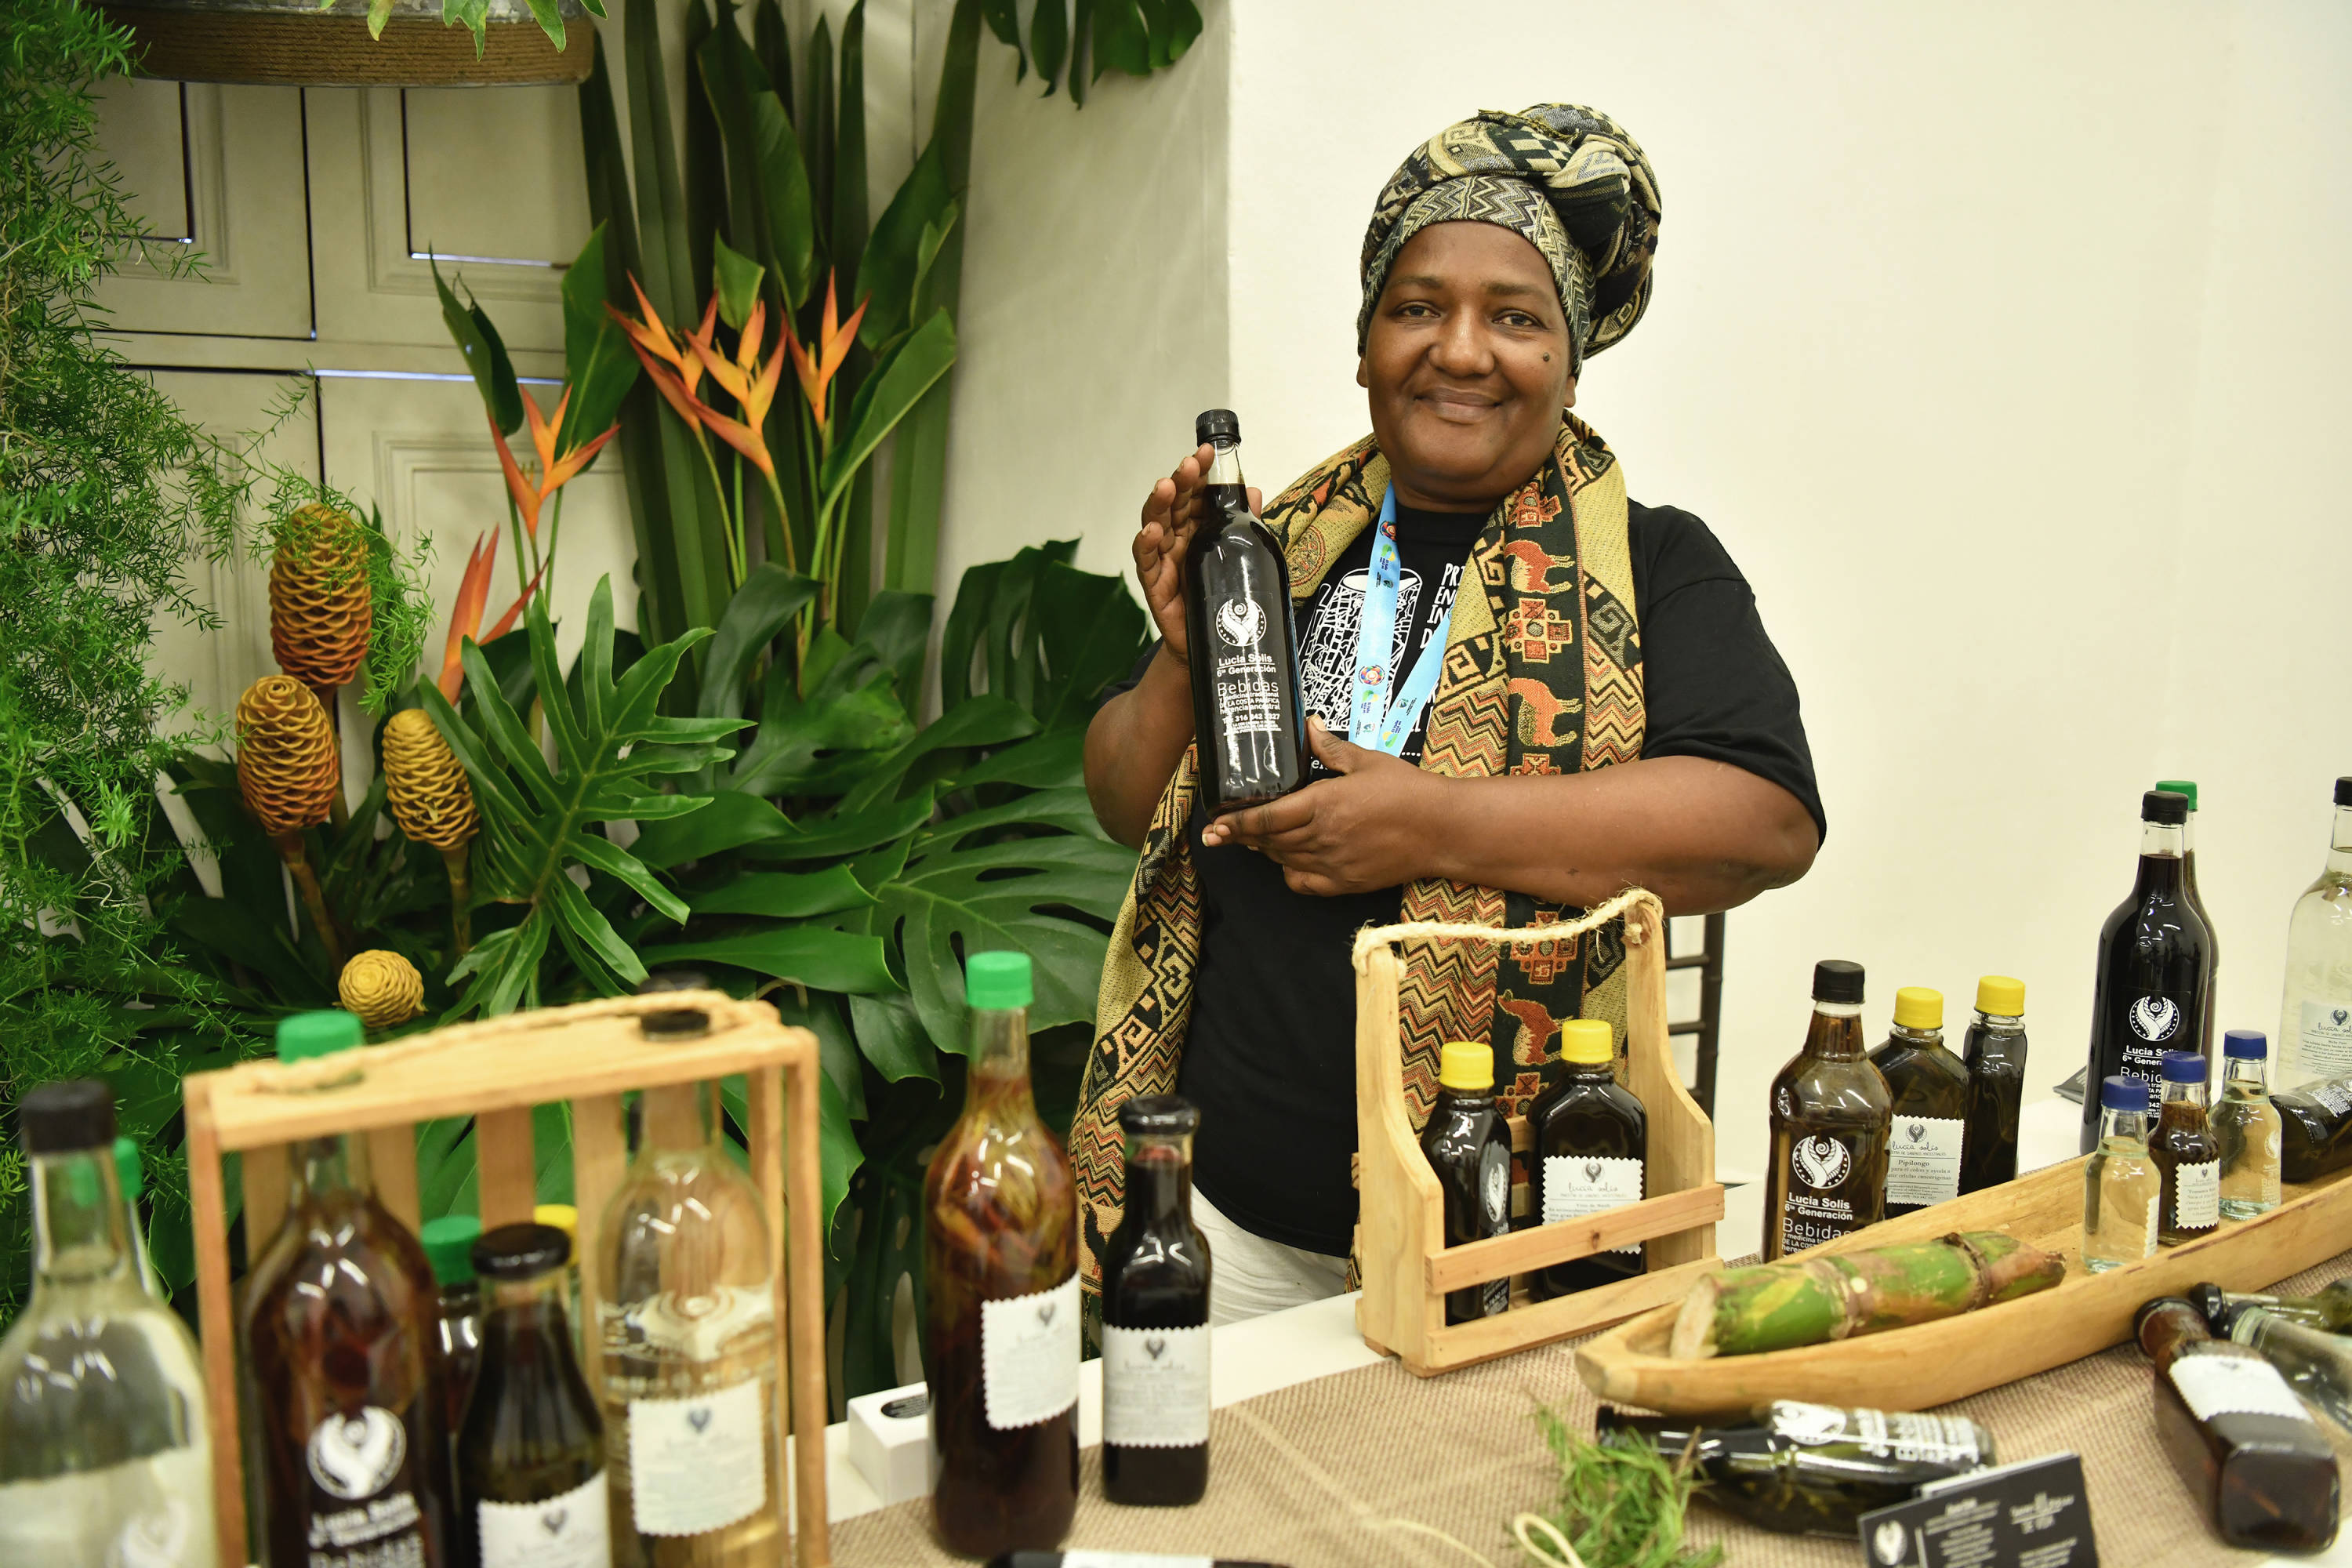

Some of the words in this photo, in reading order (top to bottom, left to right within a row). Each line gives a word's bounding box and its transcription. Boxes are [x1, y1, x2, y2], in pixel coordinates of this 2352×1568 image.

[1218, 655, 1246, 667] Lucia
[1217, 678, 1279, 697] Bebidas
[2125, 1045, 2153, 1056] Lucia
[2134, 1057, 2162, 1065] Gener
[1788, 1192, 1819, 1207] Lucia
[1821, 1197, 1850, 1210] Solis
[1798, 1206, 1853, 1221] Generación
[1787, 1233, 1816, 1243] medicina
